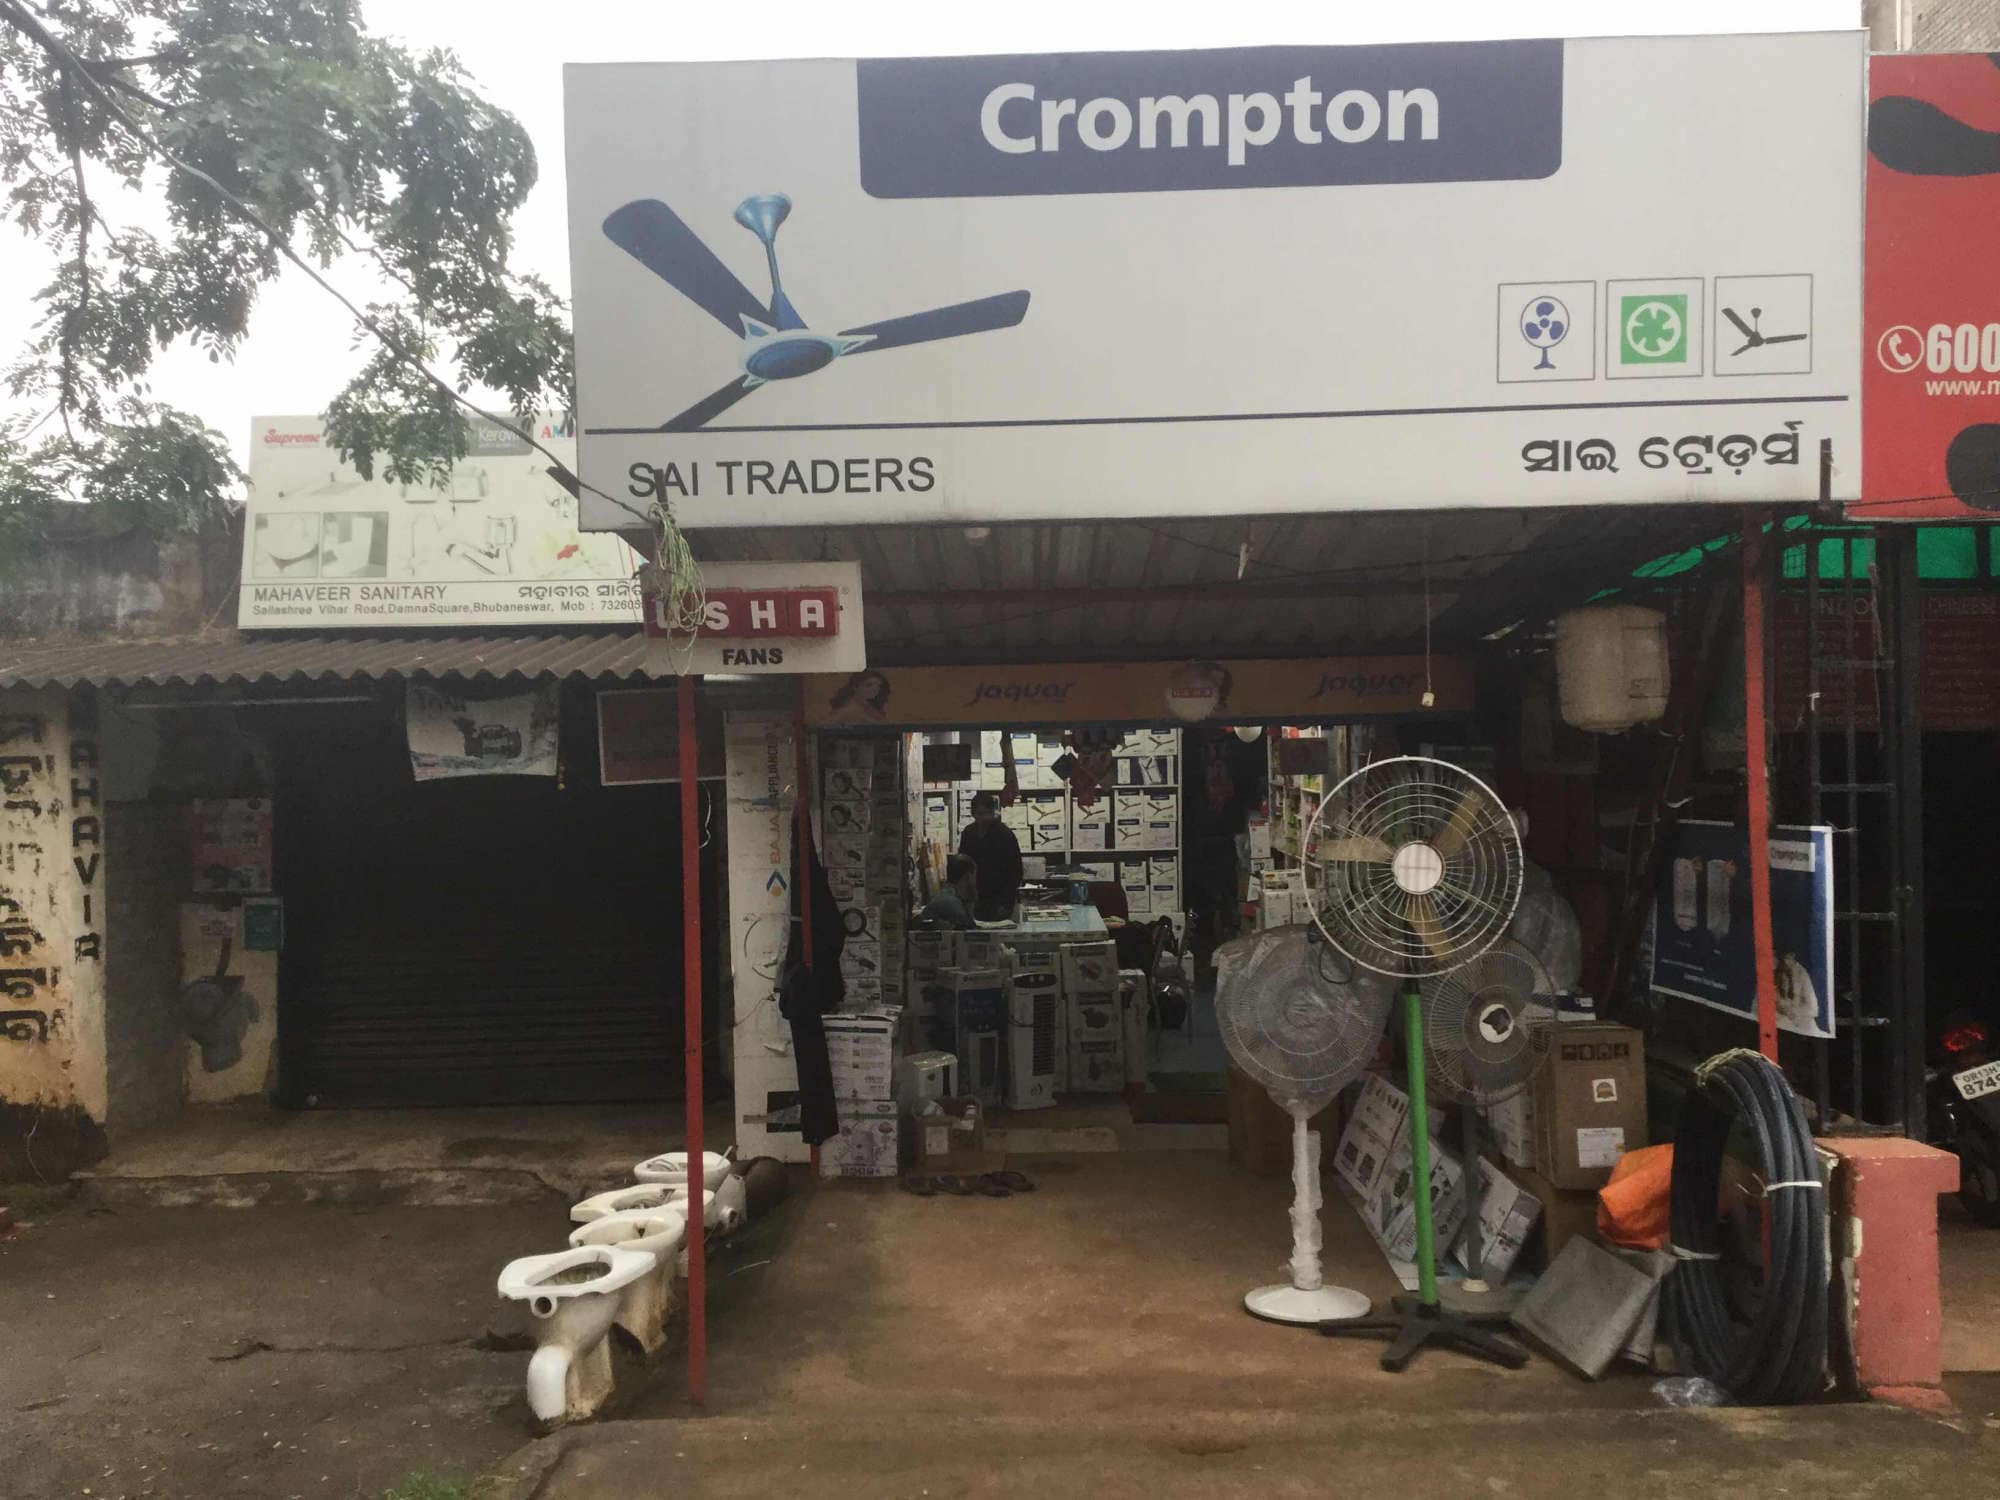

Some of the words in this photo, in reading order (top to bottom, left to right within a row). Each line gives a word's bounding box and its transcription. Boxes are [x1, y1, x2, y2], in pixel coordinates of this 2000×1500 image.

[980, 75, 1440, 166] Crompton
[1926, 322, 2000, 374] 600
[263, 428, 321, 446] Supreme
[478, 426, 530, 442] Kerovi
[1521, 438, 1620, 474] ସାଇ
[629, 462, 698, 499] SAI
[715, 455, 936, 497] TRADERS
[254, 586, 351, 602] MAHAVEER
[359, 584, 447, 601] SANITARY
[561, 600, 585, 612] Mob
[722, 647, 784, 666] FANS
